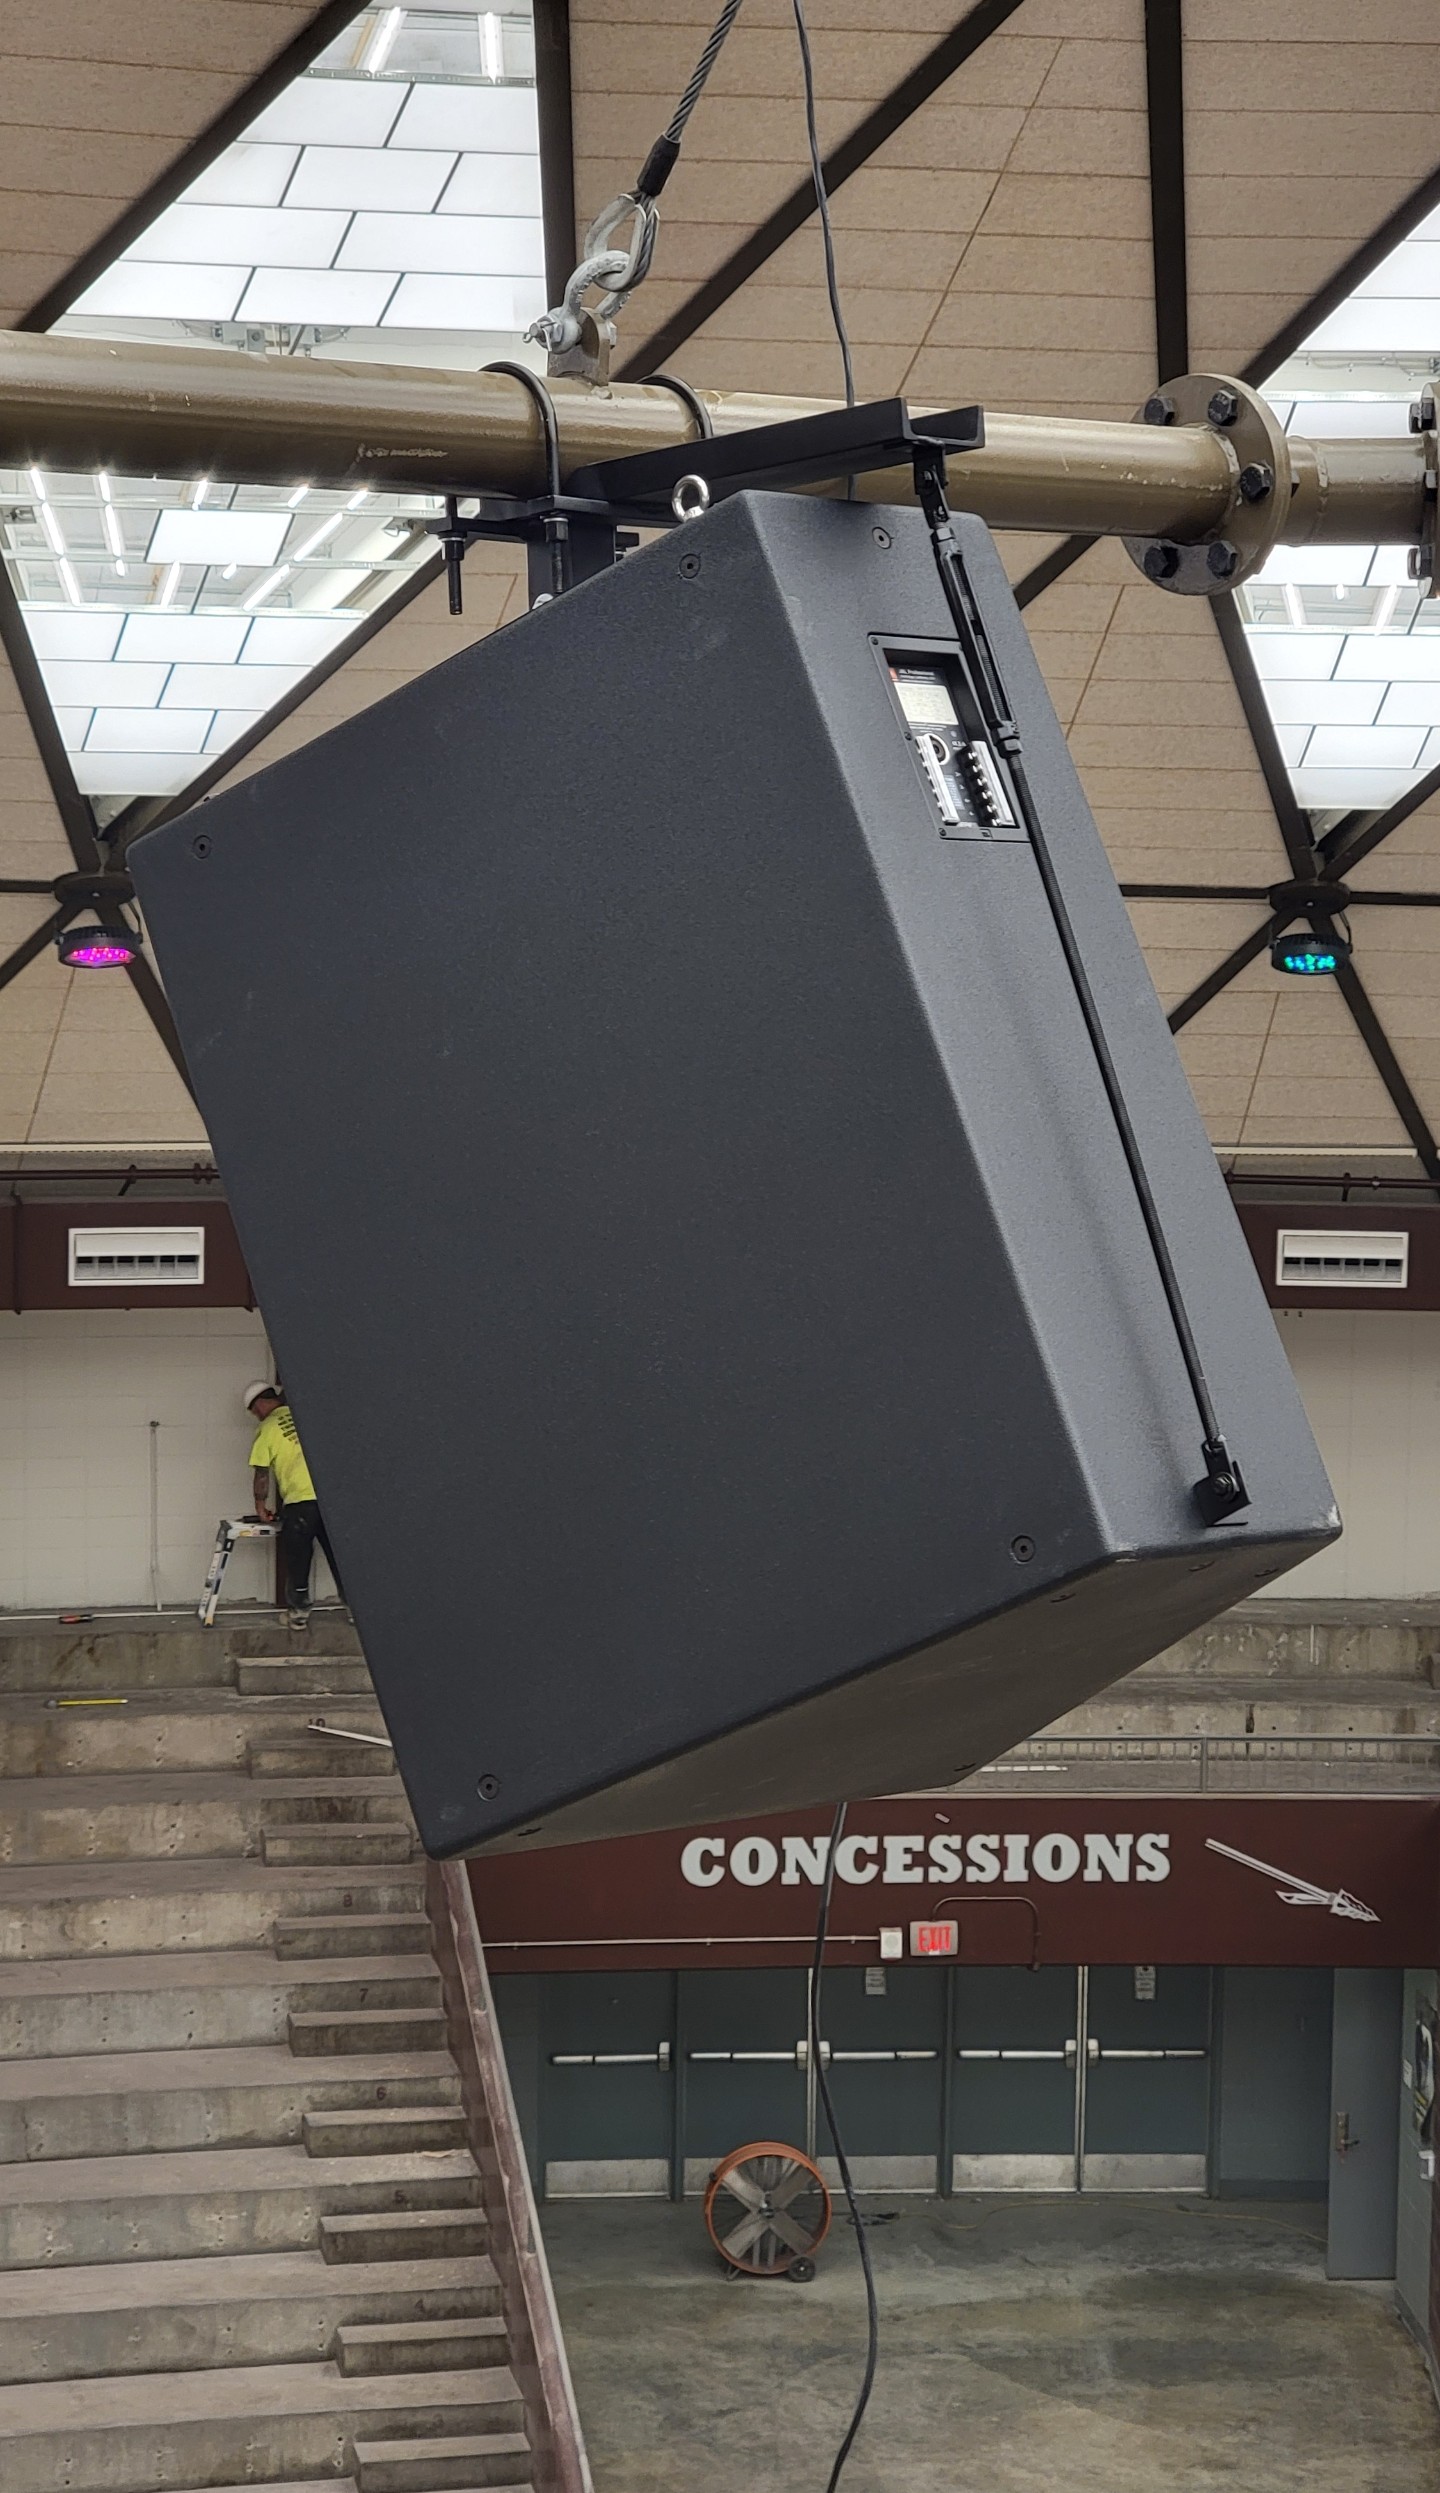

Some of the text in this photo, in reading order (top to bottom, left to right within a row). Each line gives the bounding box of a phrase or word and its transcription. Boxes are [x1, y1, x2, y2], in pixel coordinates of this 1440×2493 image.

[681, 1833, 1171, 1888] CONCESSIONS
[917, 1925, 952, 1954] EXIT
[359, 1987, 369, 2003] 7
[376, 2086, 387, 2101] 6
